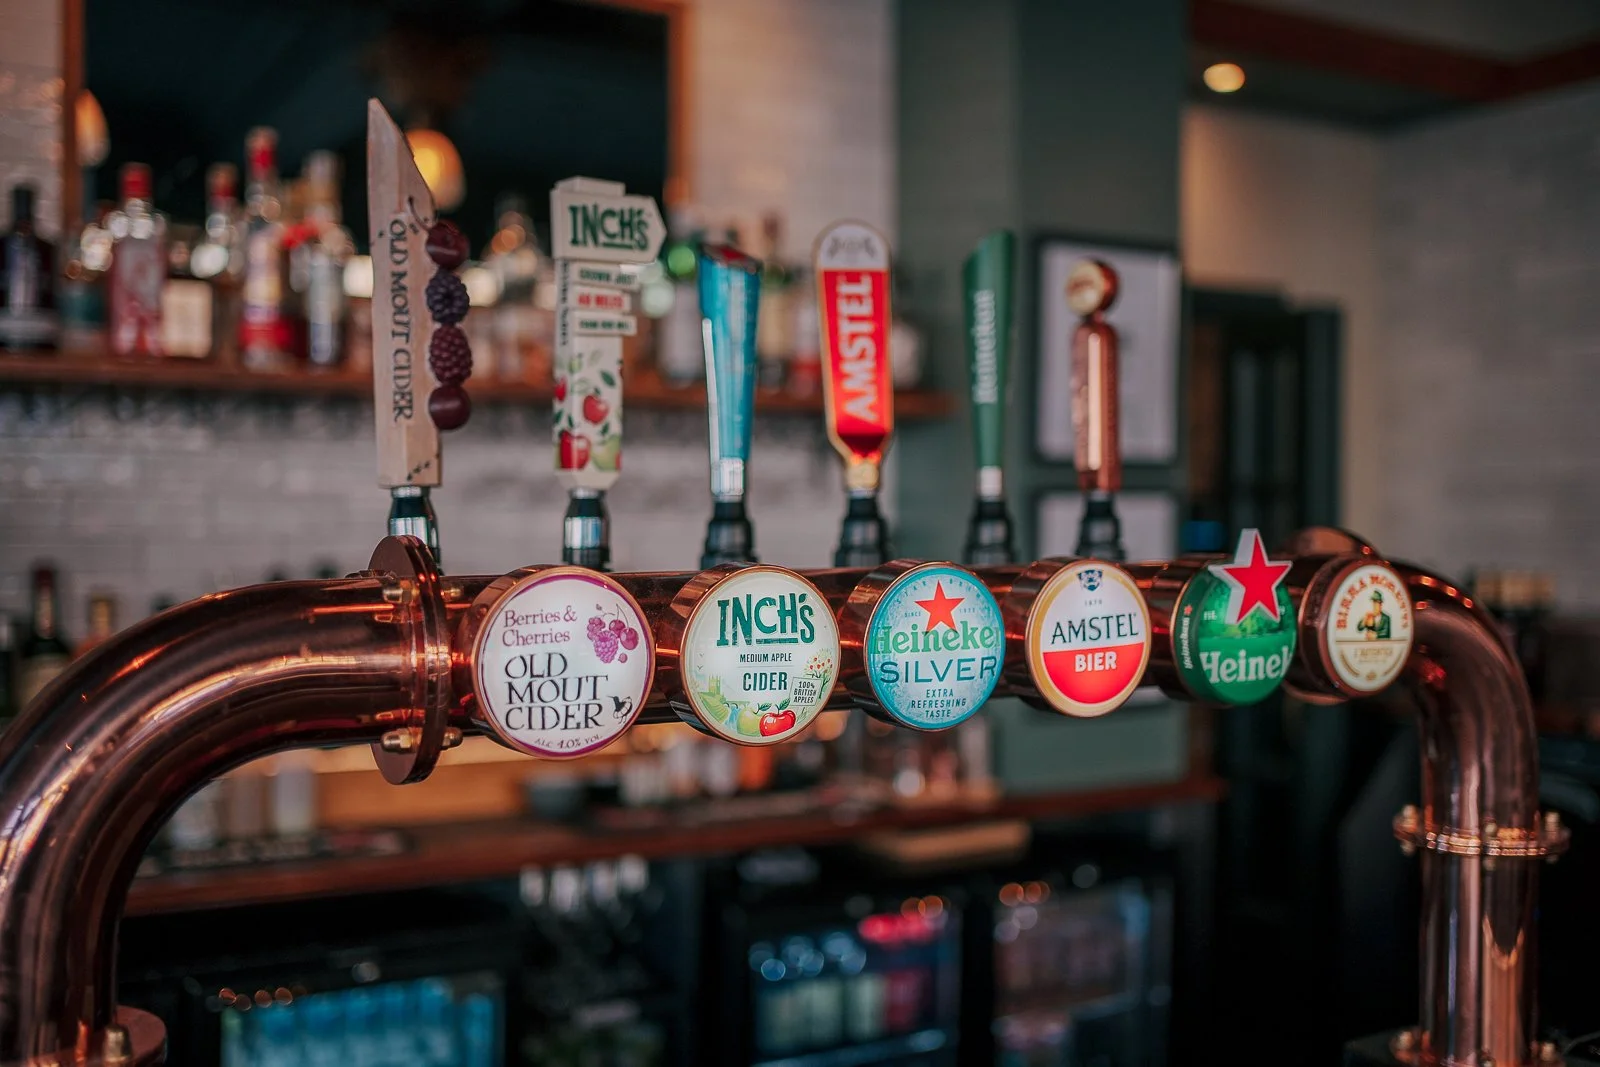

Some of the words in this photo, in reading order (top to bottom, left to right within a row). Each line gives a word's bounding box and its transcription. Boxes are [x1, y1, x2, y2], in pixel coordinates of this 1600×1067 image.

[568, 202, 649, 252] INCH'S
[389, 218, 409, 266] OLD
[390, 270, 411, 344] MOUT
[835, 273, 879, 422] AMSTEL
[393, 349, 414, 423] CIDER
[503, 609, 561, 628] Berries
[563, 605, 578, 623] &
[716, 592, 815, 647] INCH'S
[1051, 613, 1140, 645] AMSTEL
[502, 628, 571, 647] Cherries
[504, 651, 568, 679] OLD
[739, 653, 769, 663] MEDIUM
[771, 652, 793, 663] APPLE
[880, 655, 997, 684] SILVER
[1074, 651, 1118, 673] BIER
[504, 674, 609, 705] MOUT
[742, 671, 788, 692] CIDER
[793, 688, 817, 697] BRITISH
[926, 689, 954, 698] EXTRA
[793, 696, 815, 704] APPLES
[910, 697, 967, 709] REFRESHING
[925, 709, 951, 719] TASTE
[505, 702, 606, 731] CIDER
